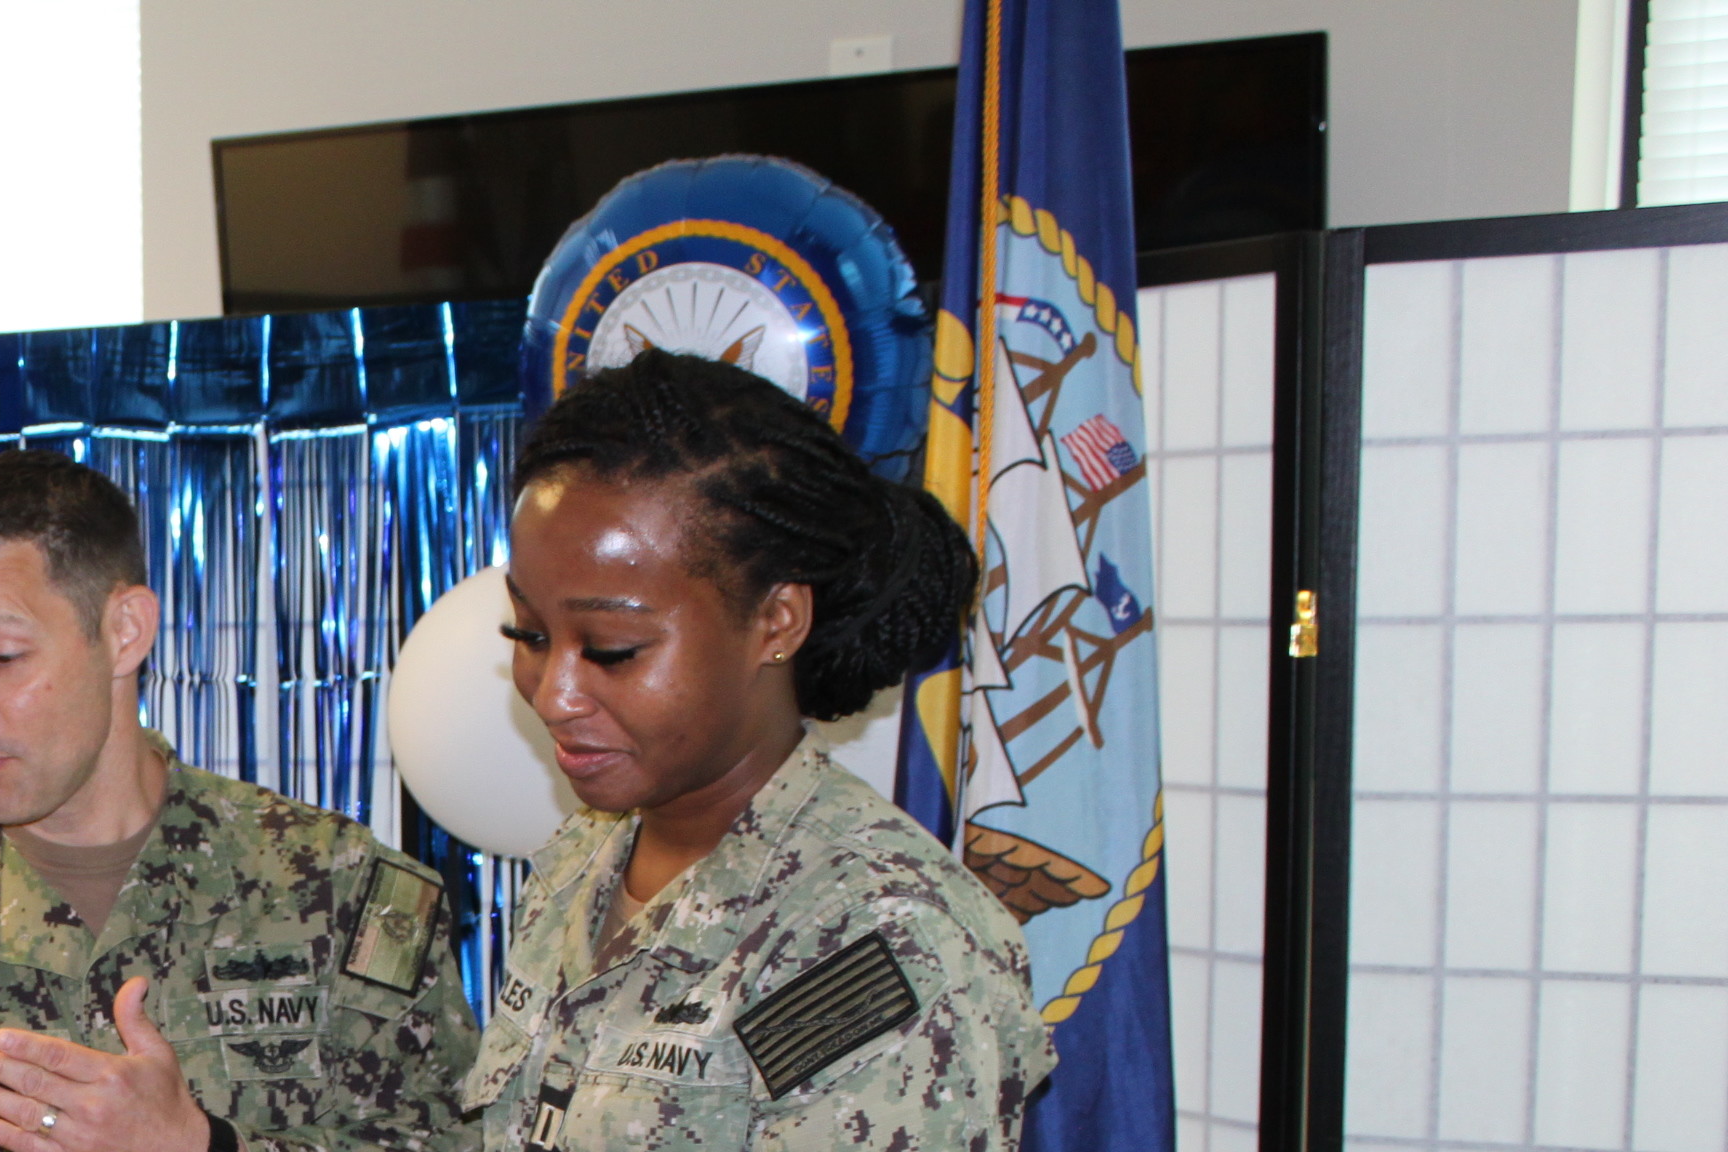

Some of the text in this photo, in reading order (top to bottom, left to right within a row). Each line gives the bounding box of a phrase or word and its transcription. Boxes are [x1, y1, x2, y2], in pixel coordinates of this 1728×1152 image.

[566, 250, 834, 413] NITED STATES
[205, 996, 318, 1026] U.S. NAVY
[499, 972, 533, 1012] LES
[617, 1041, 713, 1079] U.S. NAVY
